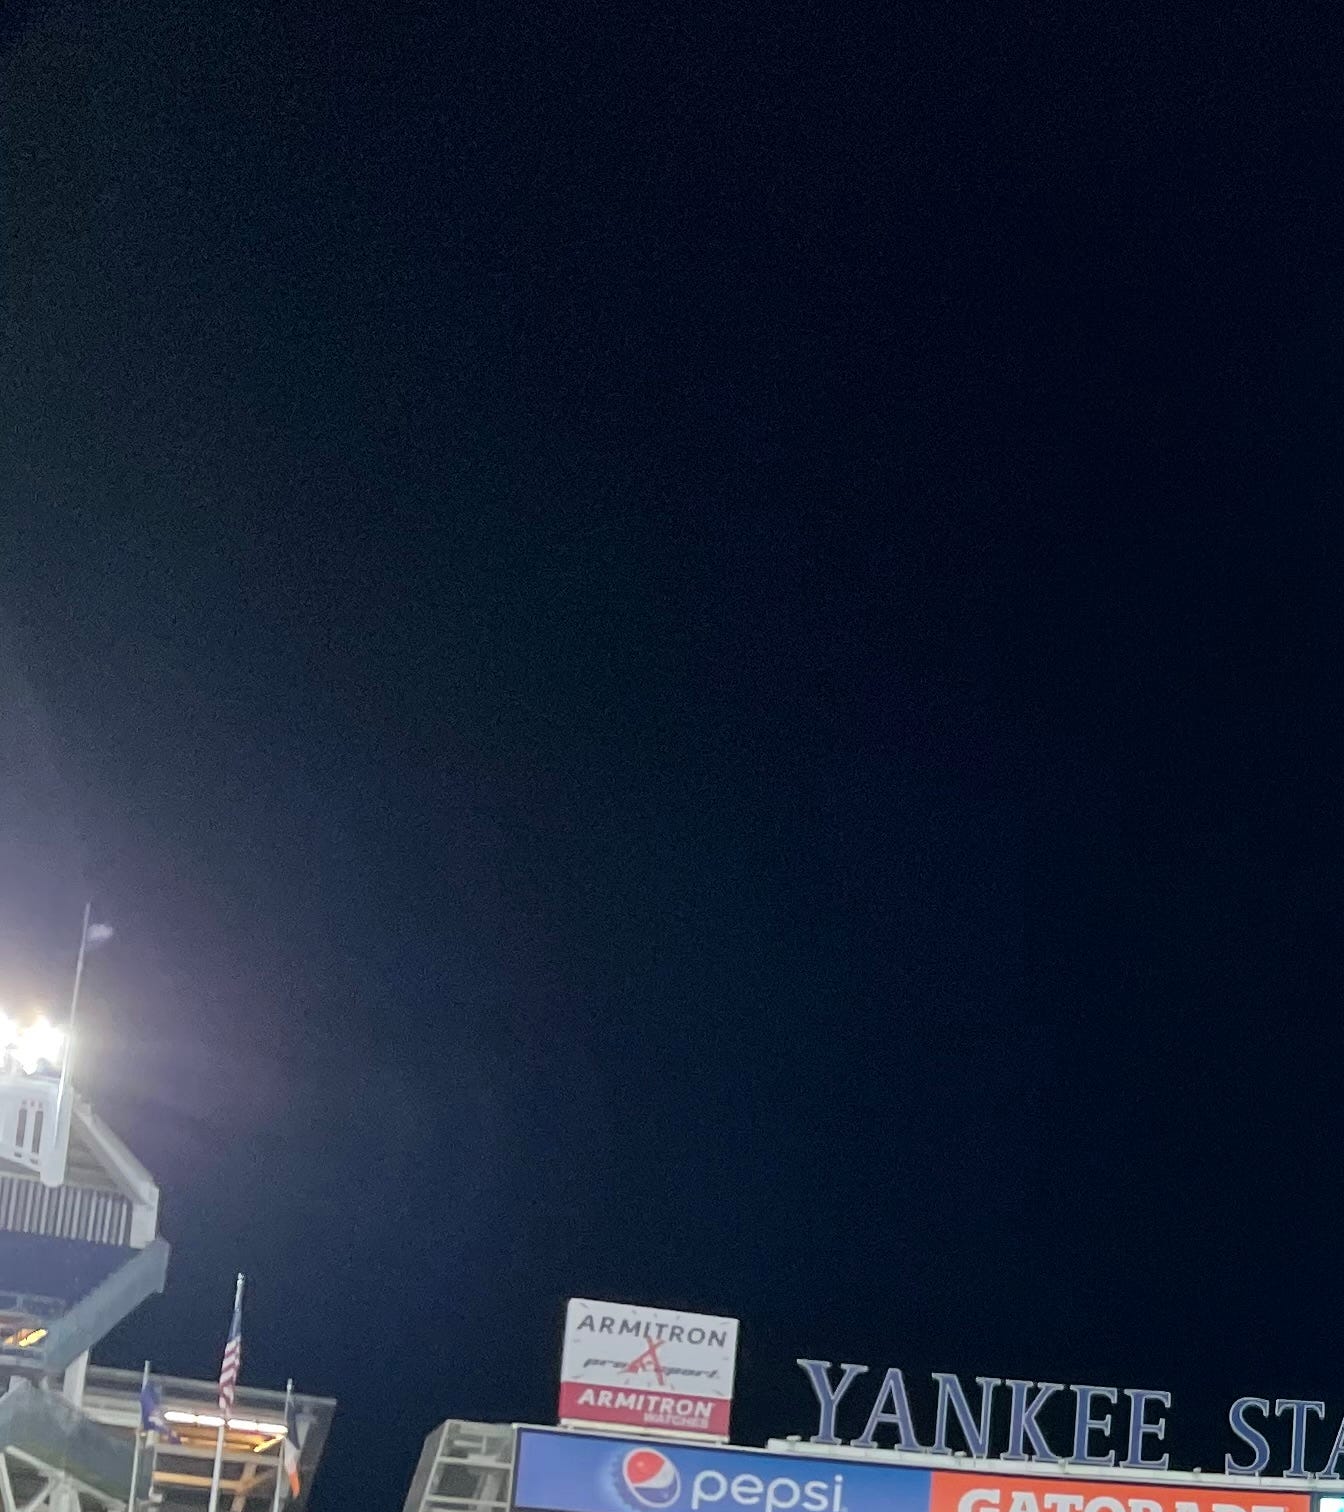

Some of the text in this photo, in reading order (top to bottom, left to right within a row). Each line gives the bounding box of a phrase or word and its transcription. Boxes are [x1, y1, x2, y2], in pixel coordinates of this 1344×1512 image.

[577, 1314, 727, 1348] ARMITRON
[577, 1388, 714, 1418] ARMITRON
[796, 1357, 1171, 1470] YANKEE
